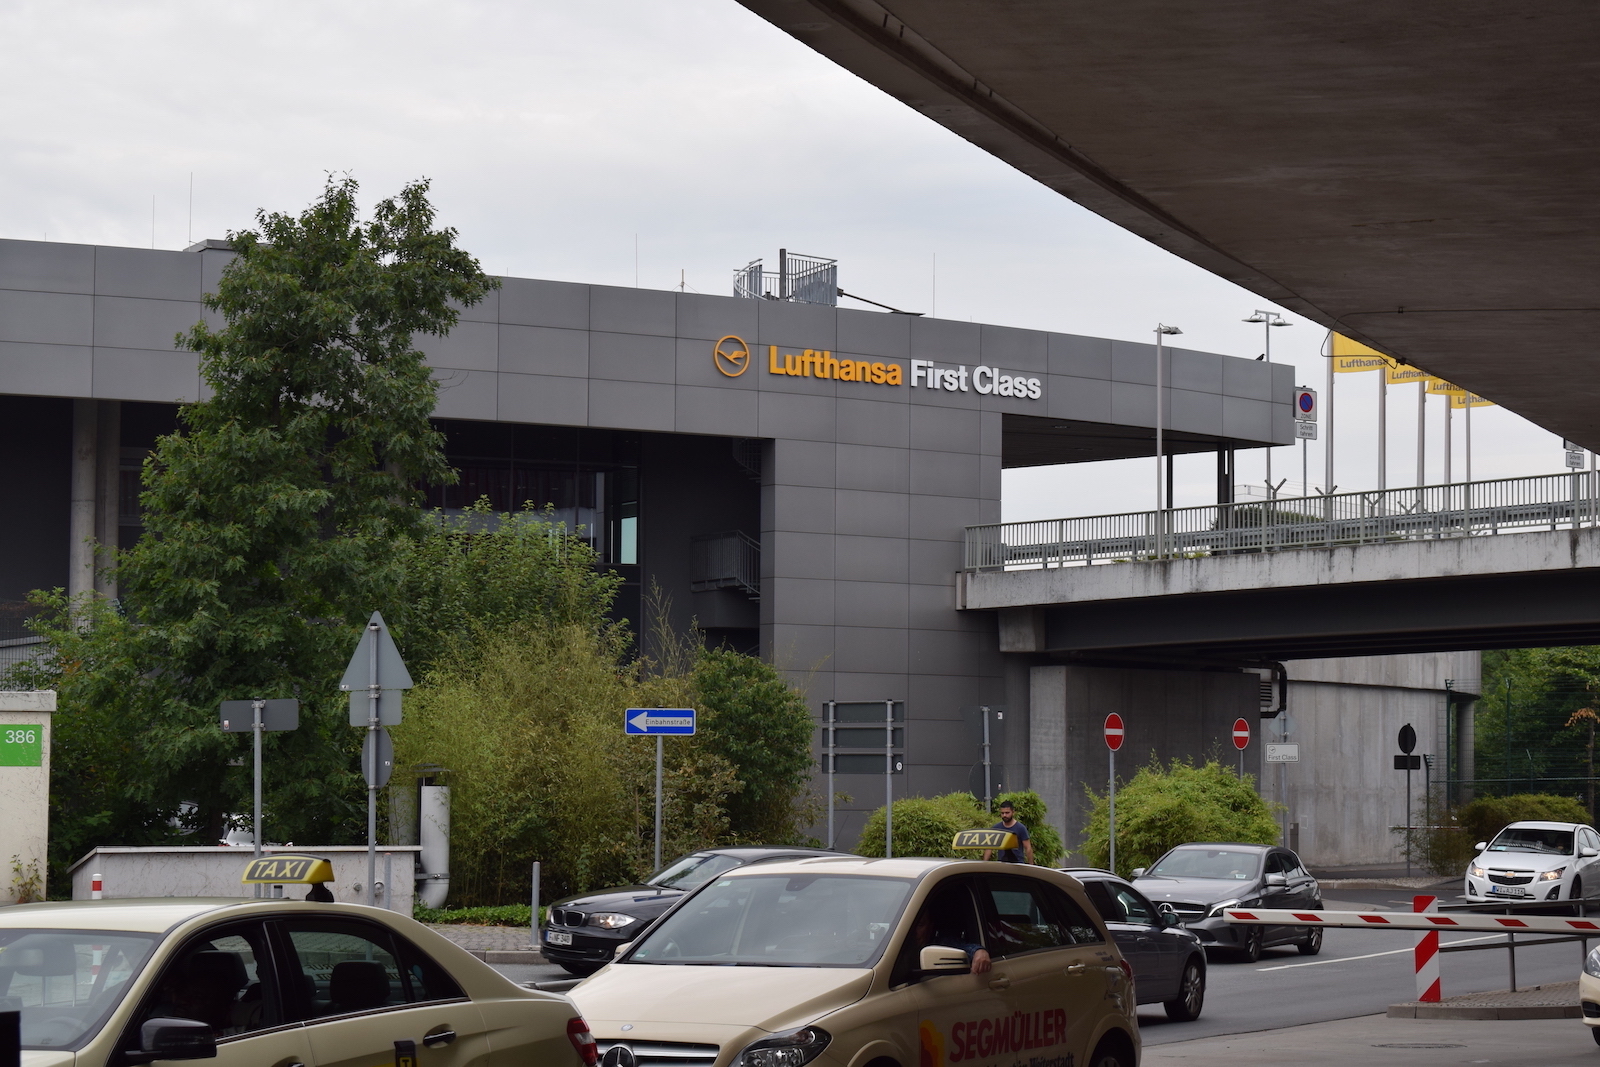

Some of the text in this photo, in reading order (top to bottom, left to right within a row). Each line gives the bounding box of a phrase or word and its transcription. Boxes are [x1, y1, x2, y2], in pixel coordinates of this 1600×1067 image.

[1340, 358, 1389, 369] Lufthansa
[768, 345, 1042, 399] Lufthansa First Class
[5, 729, 36, 744] 386
[962, 833, 1000, 846] TAXI
[254, 861, 306, 878] TAXI
[949, 1008, 1067, 1063] SEGMÜLLER
